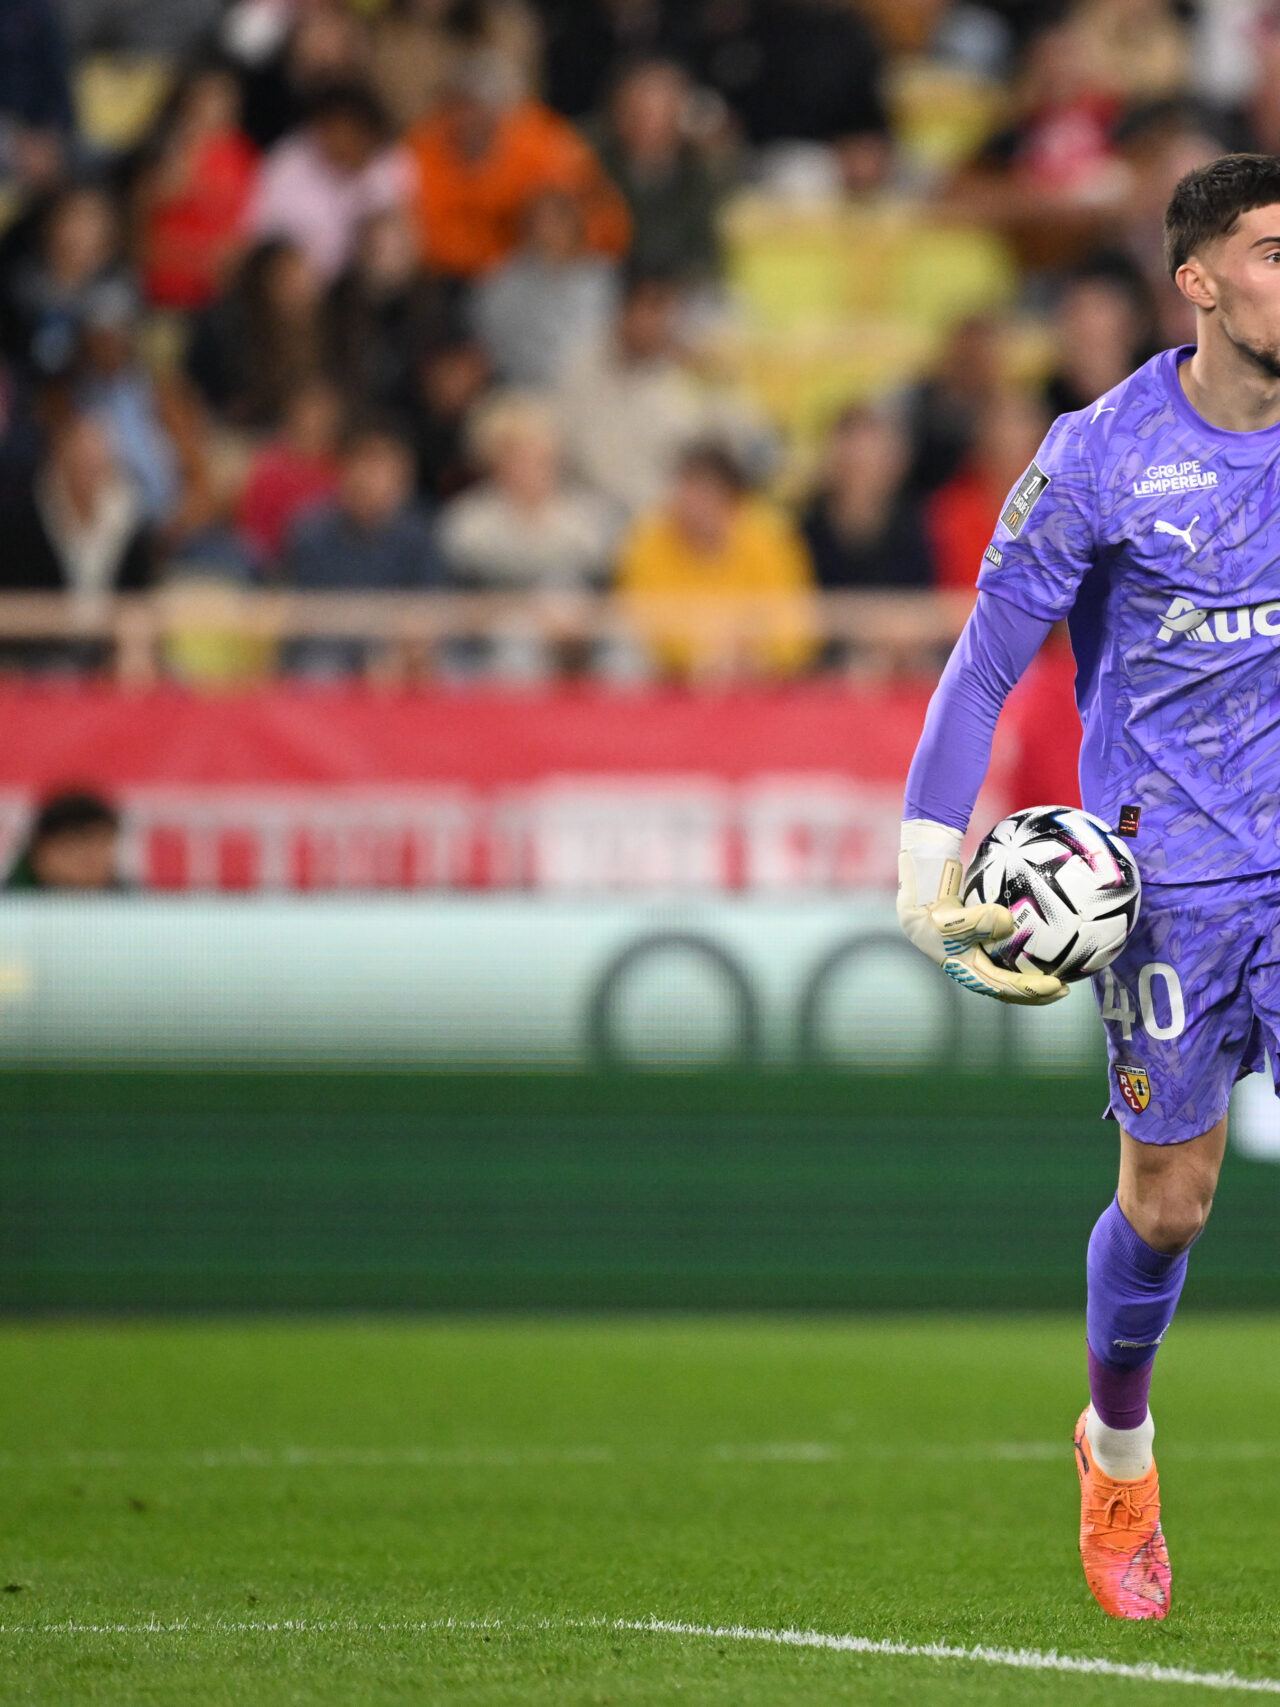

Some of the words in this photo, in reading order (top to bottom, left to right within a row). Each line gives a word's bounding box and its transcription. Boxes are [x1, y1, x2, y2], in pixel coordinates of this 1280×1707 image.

[1146, 460, 1201, 480] GROUPE
[1133, 471, 1218, 495] LEMPEREUR
[1103, 962, 1186, 1041] 40
